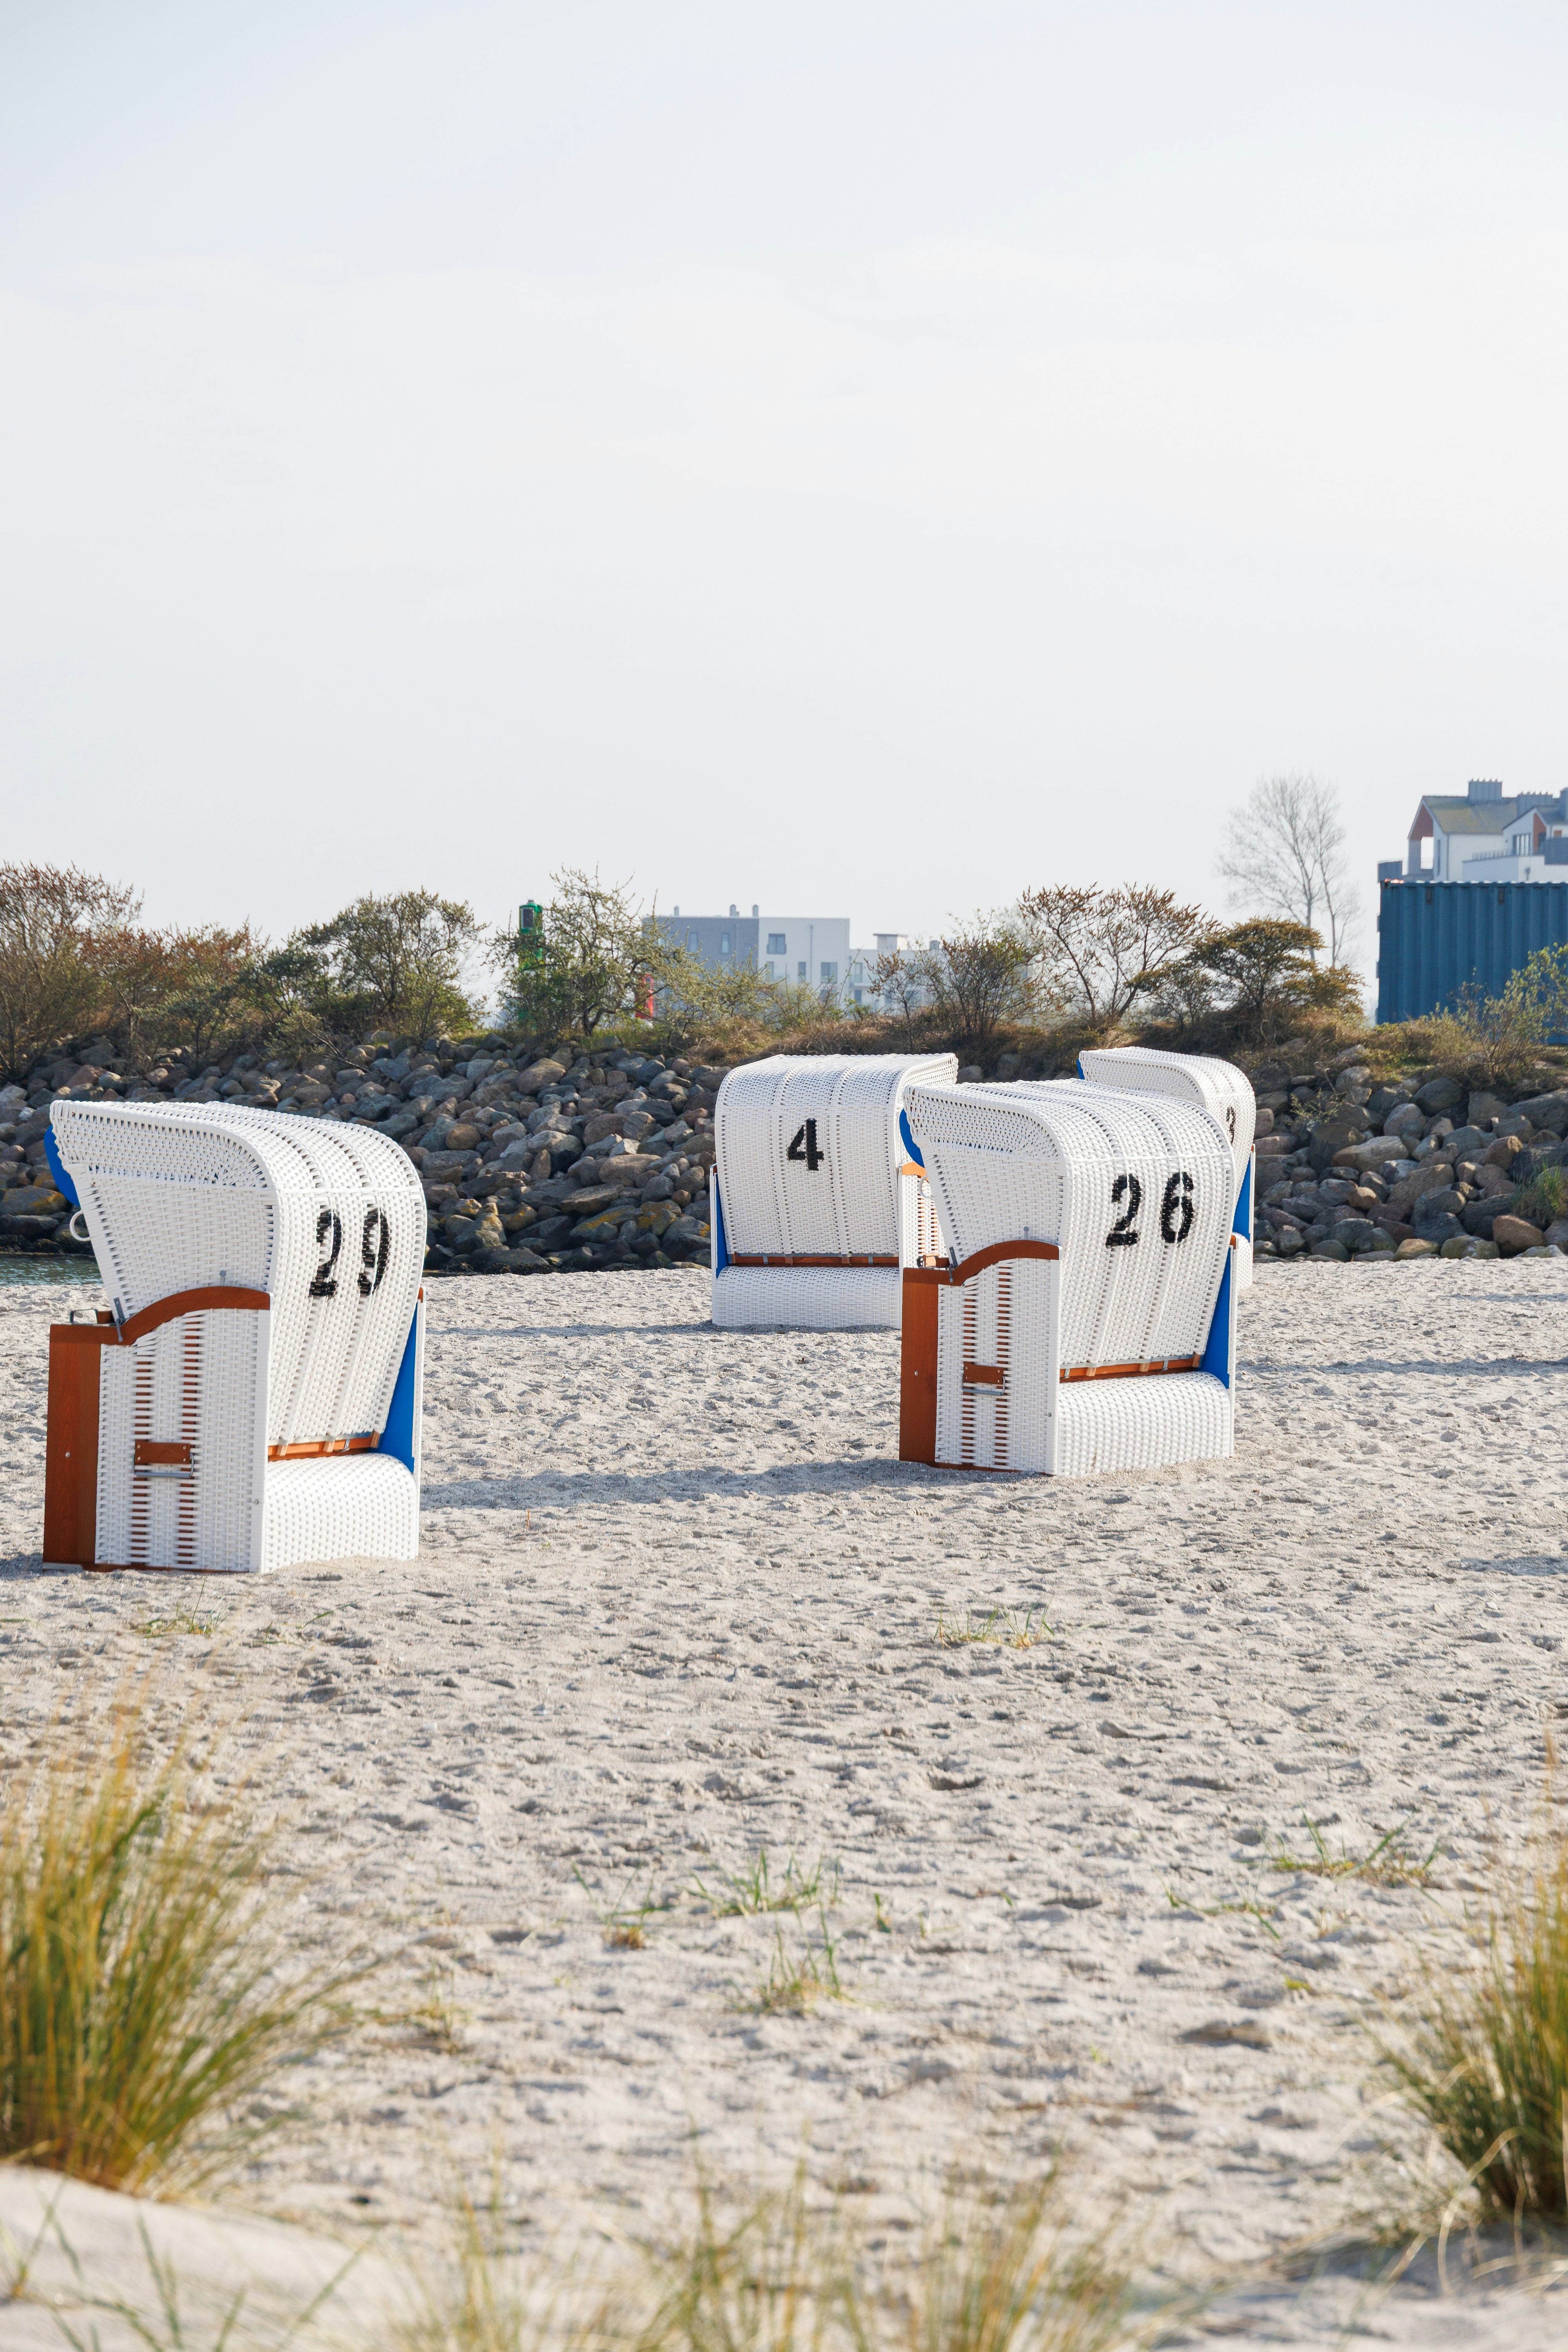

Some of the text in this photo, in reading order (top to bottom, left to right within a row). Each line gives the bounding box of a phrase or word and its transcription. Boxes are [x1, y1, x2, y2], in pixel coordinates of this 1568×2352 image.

[787, 1118, 824, 1171] 4
[1226, 1105, 1236, 1145] 3
[1105, 1172, 1194, 1247] 26
[309, 1209, 389, 1296] 29
